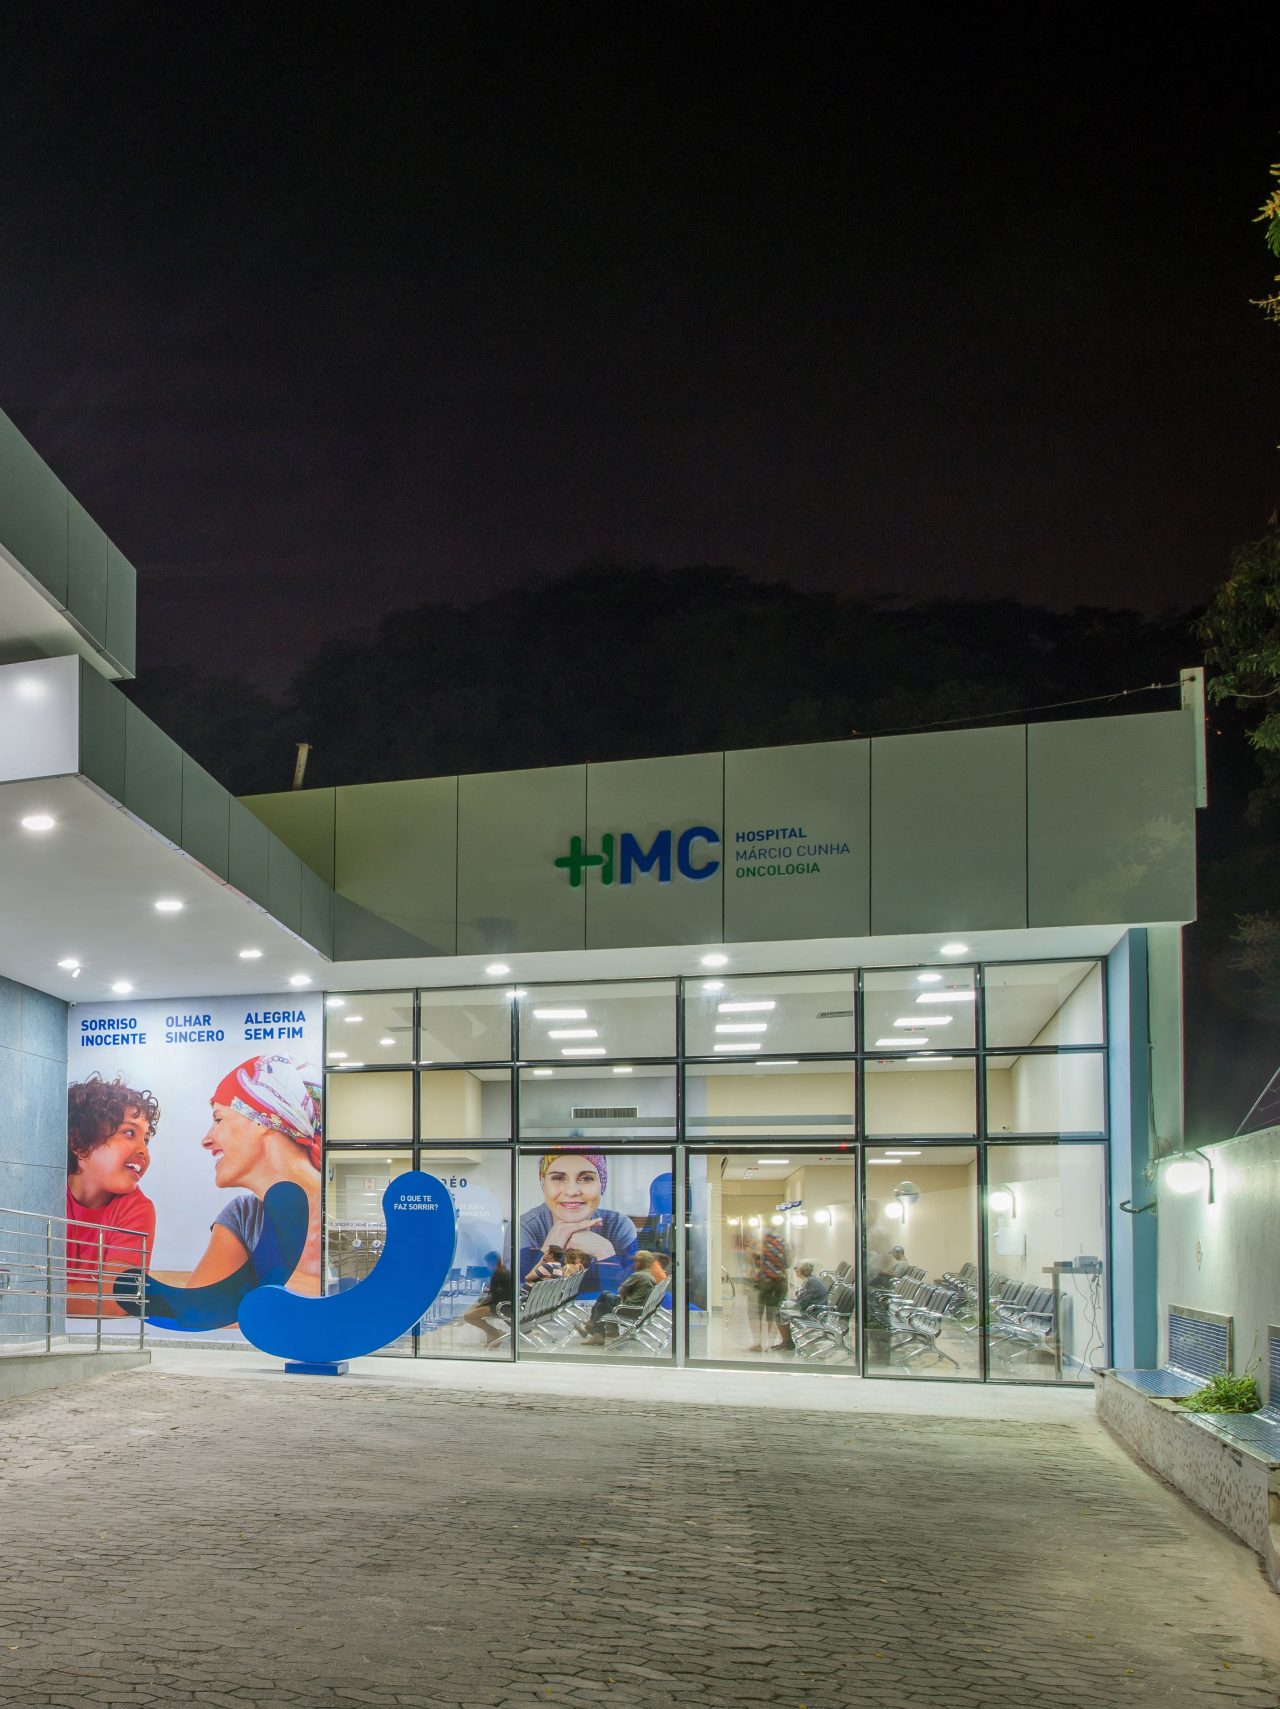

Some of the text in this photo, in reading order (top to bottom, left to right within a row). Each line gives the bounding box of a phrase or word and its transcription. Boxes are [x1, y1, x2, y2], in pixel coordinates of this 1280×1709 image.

[735, 827, 807, 843] HOSPITAL
[735, 842, 850, 862] MÁRCIO CUNHA
[735, 862, 821, 879] ONCOLOGIA
[81, 1018, 137, 1031] SORRISO
[165, 1014, 212, 1028] OLHAR
[244, 1010, 306, 1025] ALEGRIA
[81, 1032, 147, 1047] INOCENTE
[165, 1029, 225, 1044] SINCERO
[244, 1026, 304, 1041] SEM FIM
[393, 1203, 439, 1211] FAZ SORRIR?
